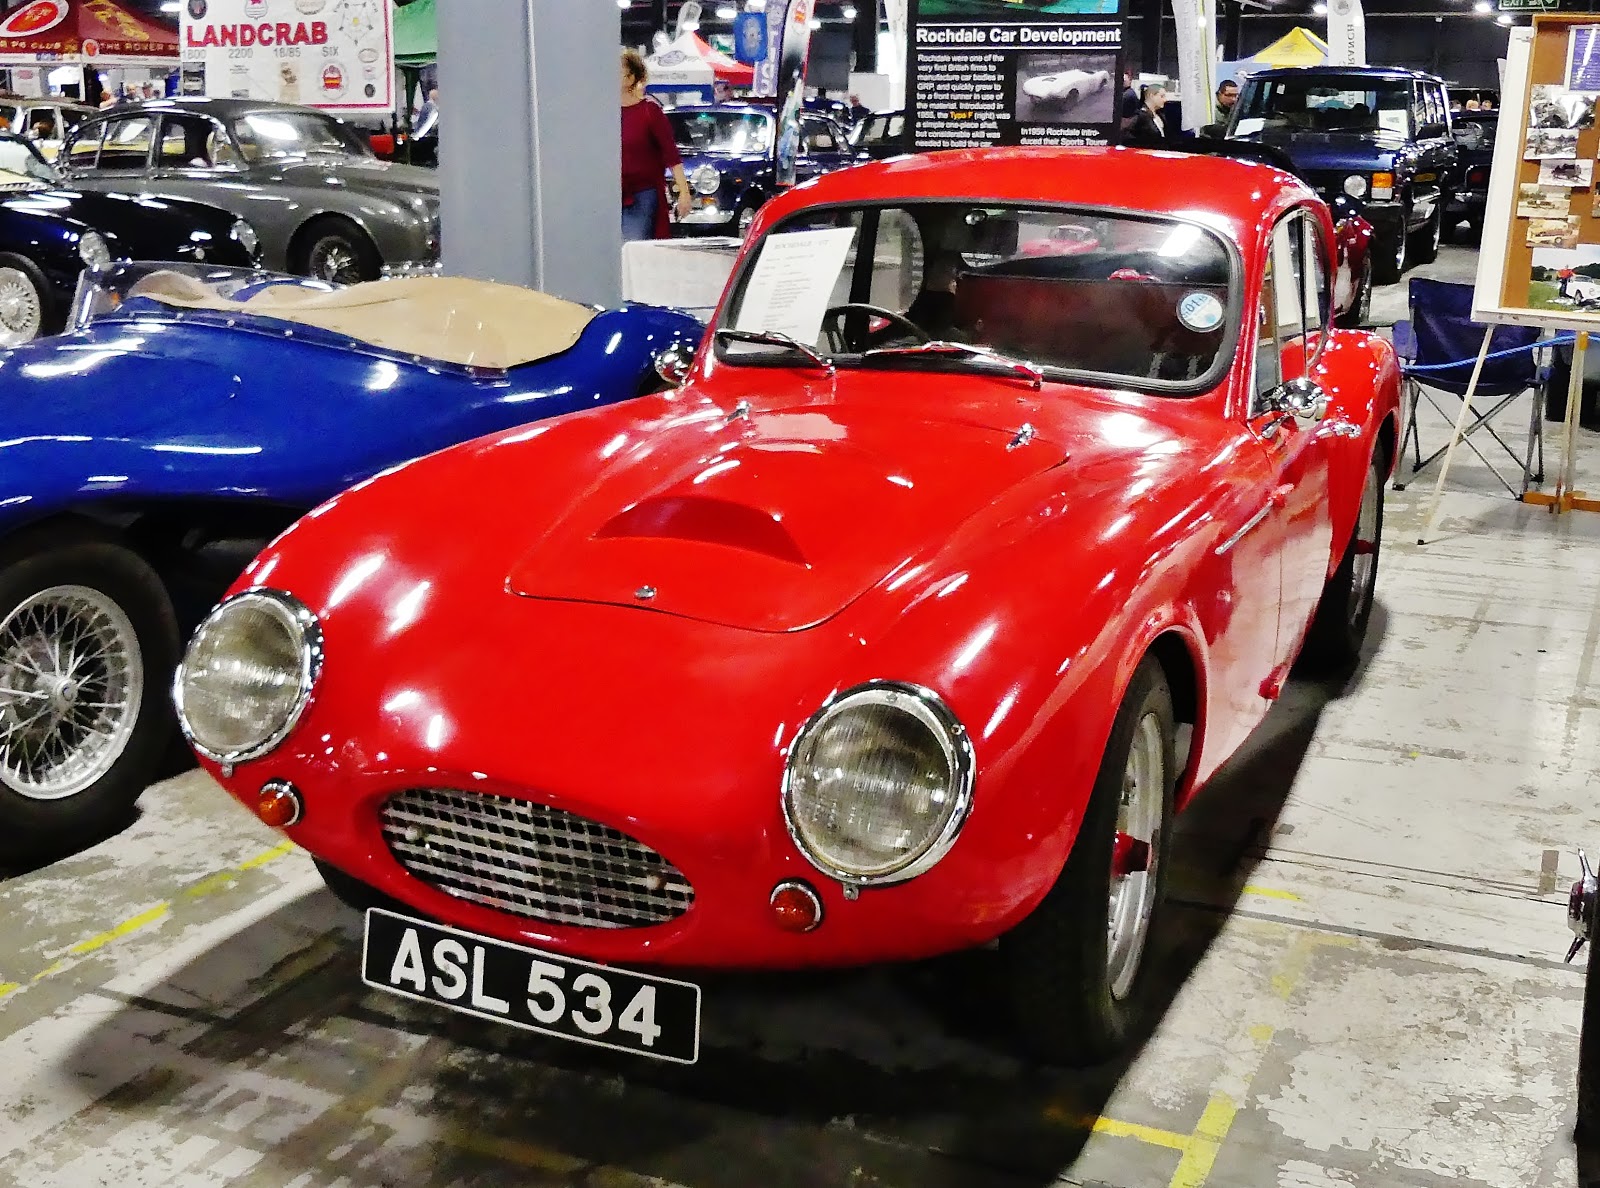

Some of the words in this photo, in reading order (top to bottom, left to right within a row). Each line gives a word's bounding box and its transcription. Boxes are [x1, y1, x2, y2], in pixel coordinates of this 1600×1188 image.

[187, 22, 328, 48] LANDCRAB
[916, 28, 986, 43] Rochdale
[990, 28, 1016, 43] Car
[1020, 28, 1121, 45] Development
[229, 49, 253, 58] 2200
[274, 48, 300, 58] 18/85
[322, 46, 338, 57] SIX
[918, 65, 933, 73] very
[950, 112, 967, 120] Type
[1046, 128, 1080, 136] Rochdale
[1060, 138, 1084, 146] Sports
[390, 928, 510, 1014] ASL
[526, 960, 662, 1046] 534
